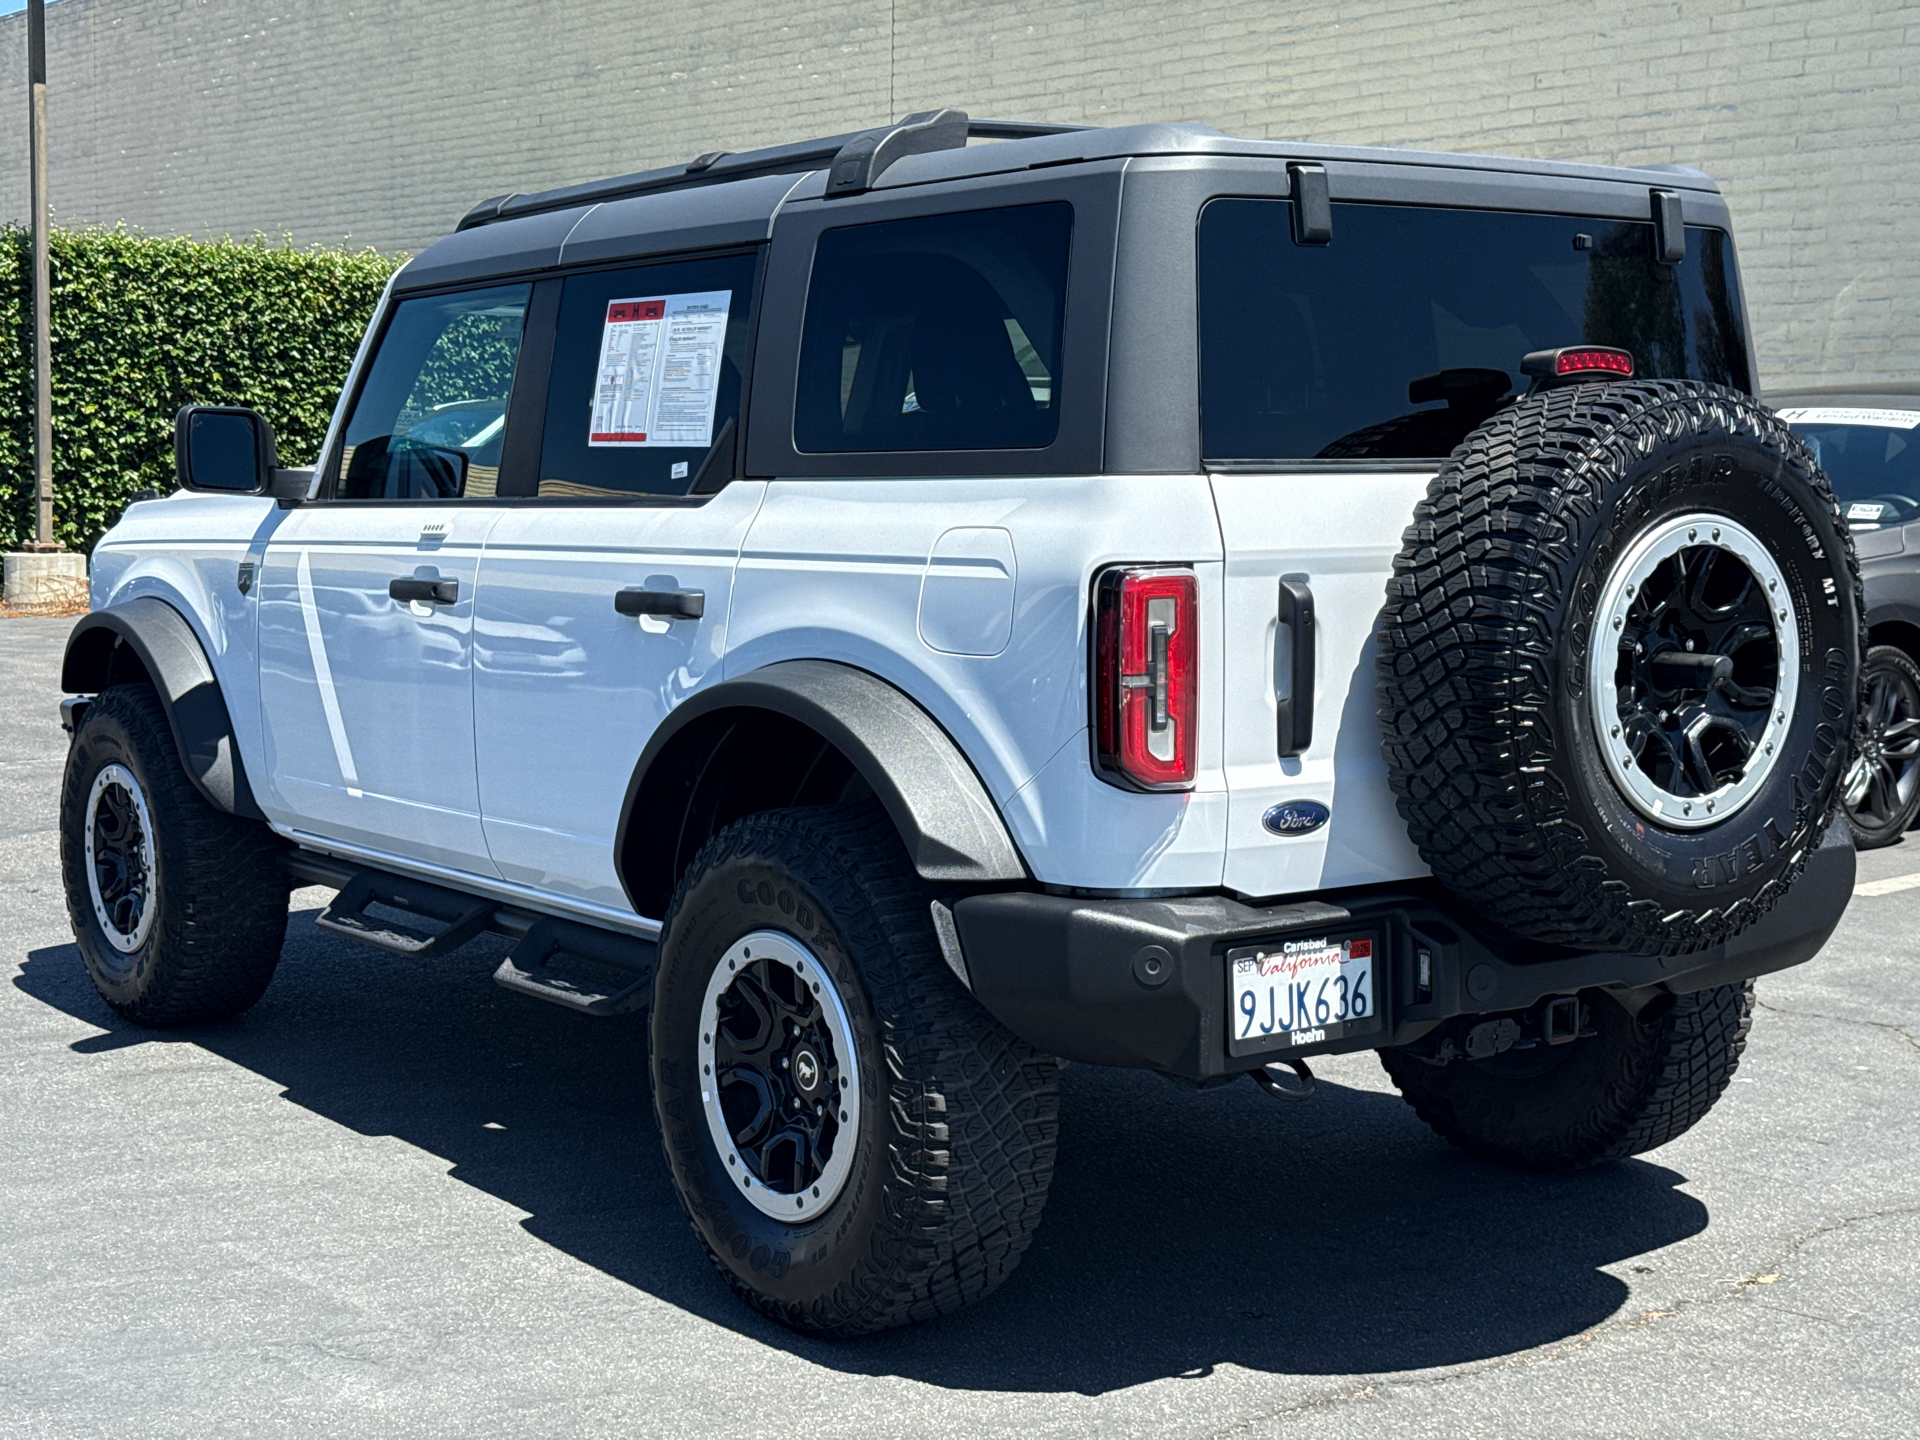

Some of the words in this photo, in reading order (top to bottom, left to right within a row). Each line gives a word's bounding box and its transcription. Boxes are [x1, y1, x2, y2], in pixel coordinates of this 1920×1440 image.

[1821, 577, 1839, 607] MT
[1280, 810, 1316, 829] Ford
[1283, 937, 1327, 953] Carlsbad
[1237, 959, 1255, 973] SEP
[1259, 952, 1350, 979] California
[1240, 970, 1367, 1038] 9JJK636
[1292, 1028, 1325, 1046] Hoehn
